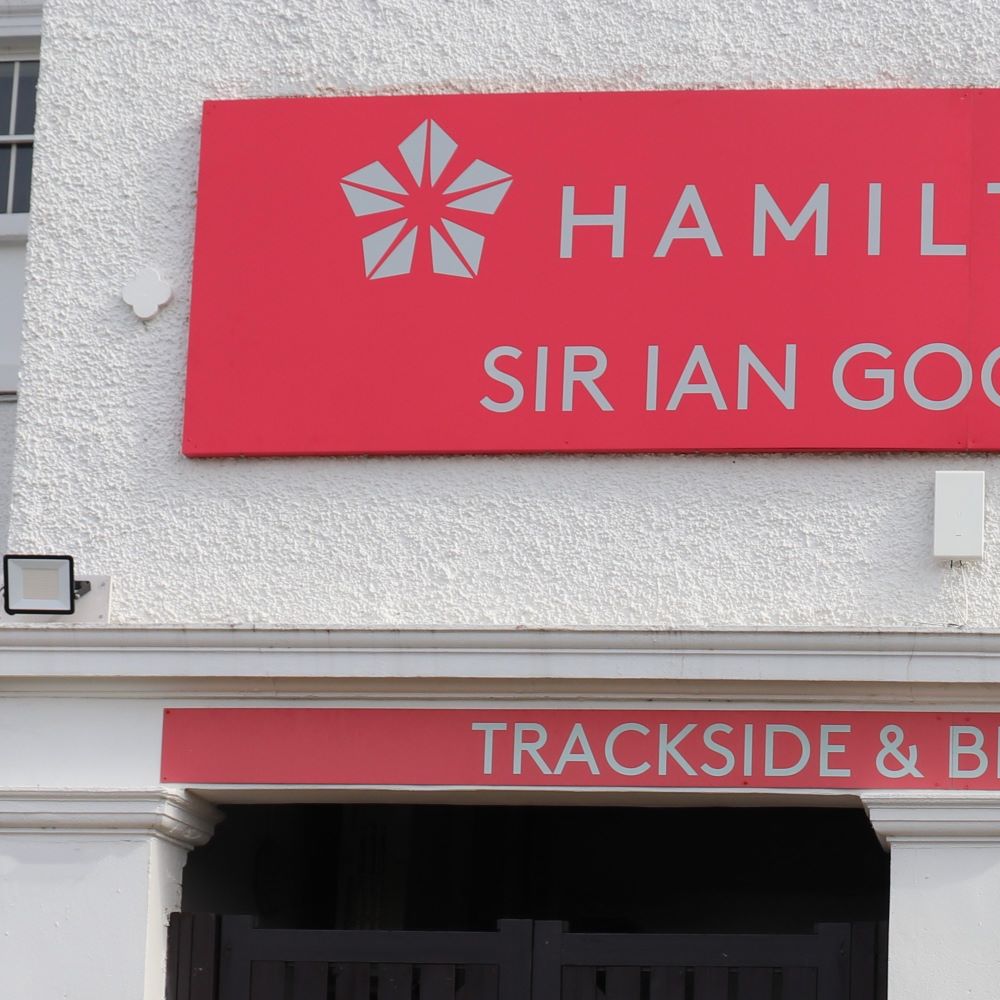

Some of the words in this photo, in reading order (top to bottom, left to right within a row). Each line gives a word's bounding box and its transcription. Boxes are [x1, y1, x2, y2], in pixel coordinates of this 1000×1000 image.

[481, 346, 614, 413] SIR
[646, 345, 798, 412] IAN
[472, 722, 852, 777] TRACKSIDE
[876, 724, 922, 779] &
